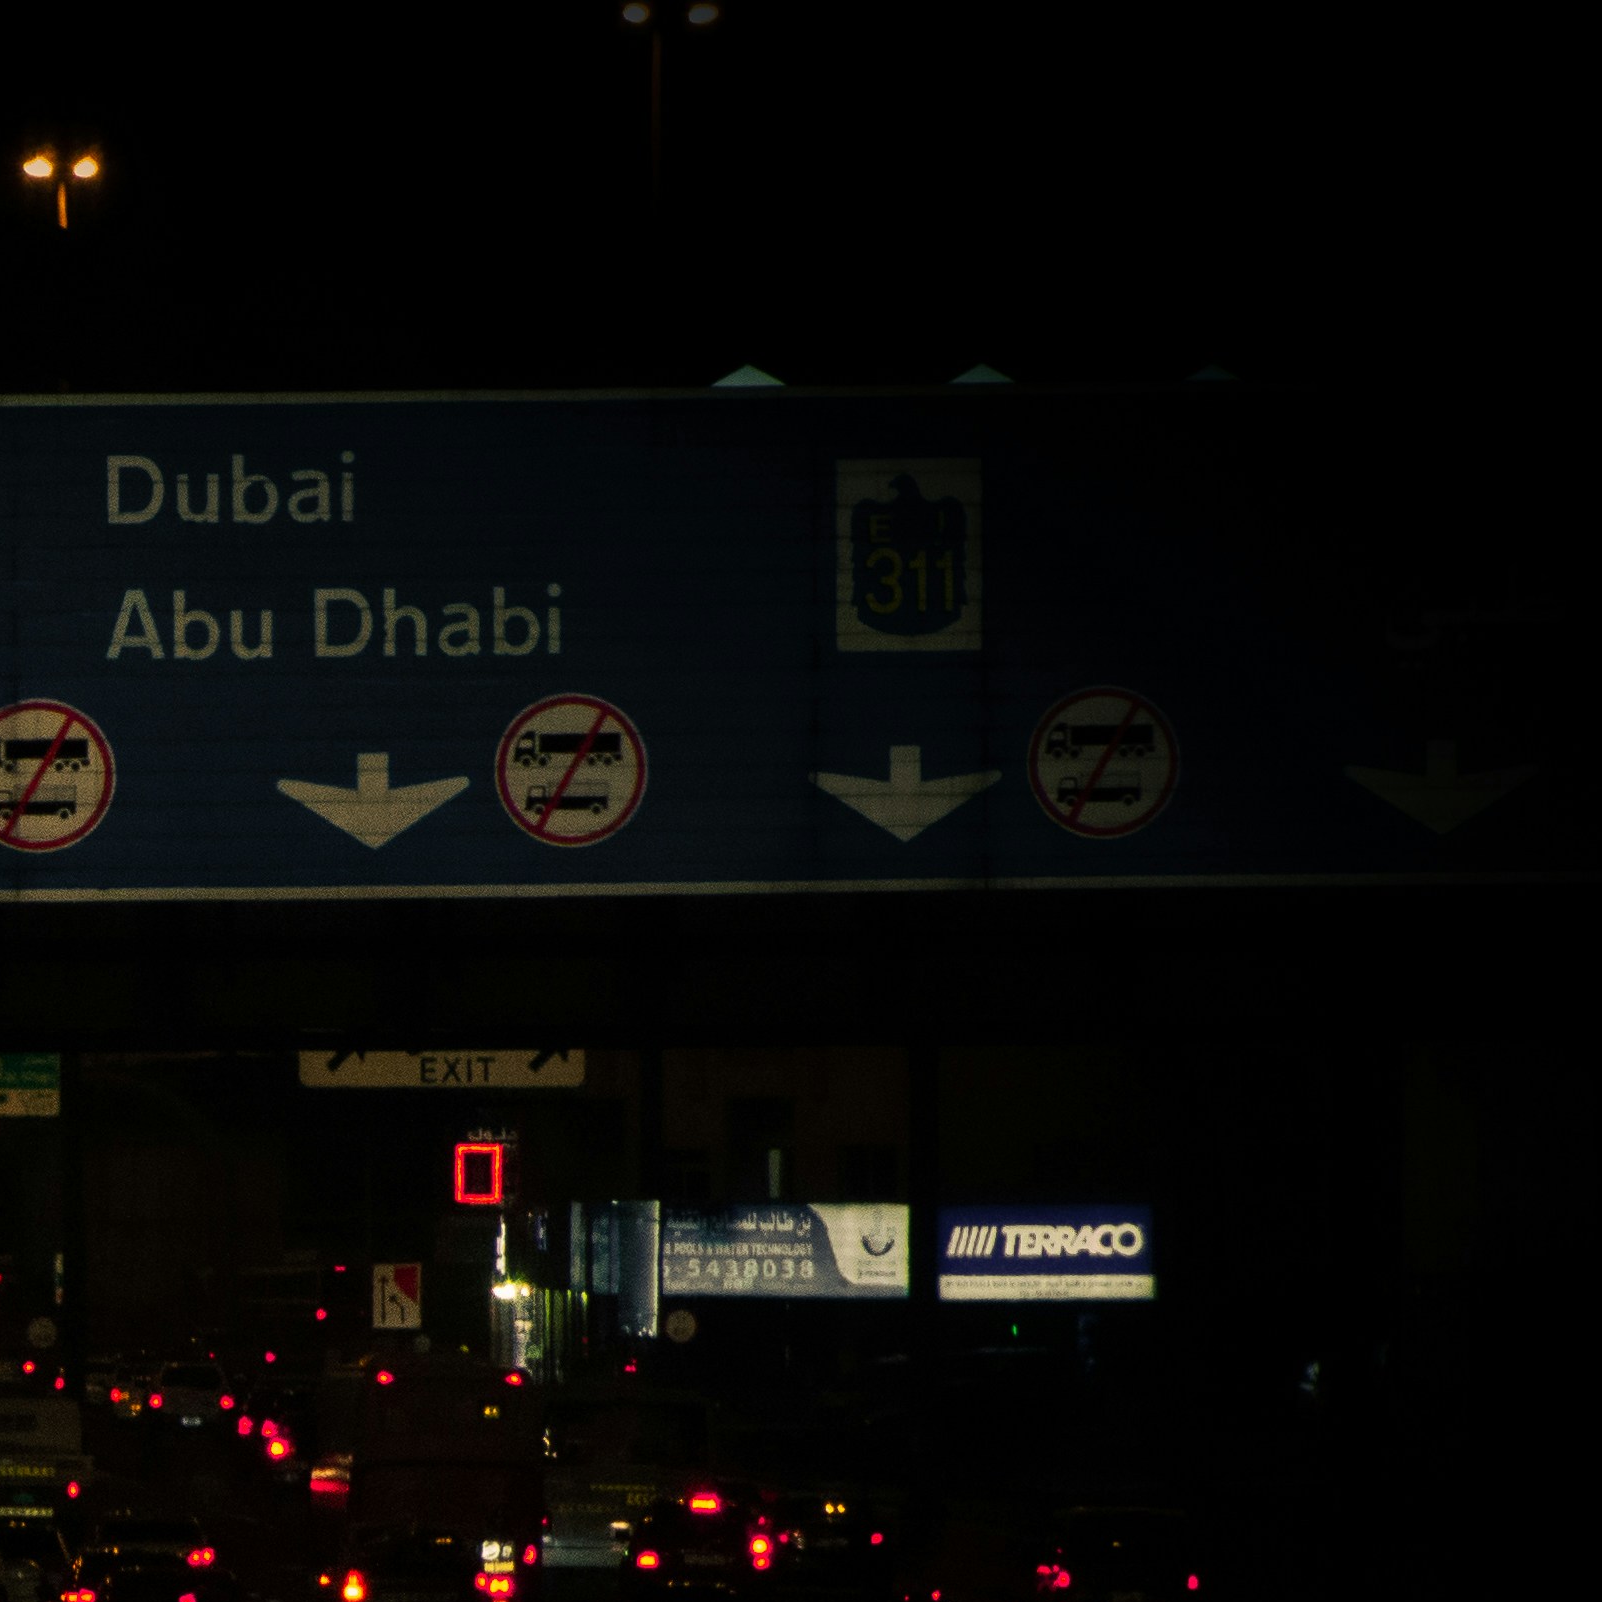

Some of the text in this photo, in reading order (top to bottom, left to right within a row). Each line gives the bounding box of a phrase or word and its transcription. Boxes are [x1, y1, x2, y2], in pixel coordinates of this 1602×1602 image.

[104, 452, 357, 525] Dubai
[869, 514, 893, 544] E
[864, 547, 955, 615] 311
[105, 583, 564, 661] Abu Dhabi
[420, 1056, 496, 1083] EXIT
[751, 1242, 814, 1257] TECHNOLOGY
[1001, 1222, 1145, 1258] TERRACO
